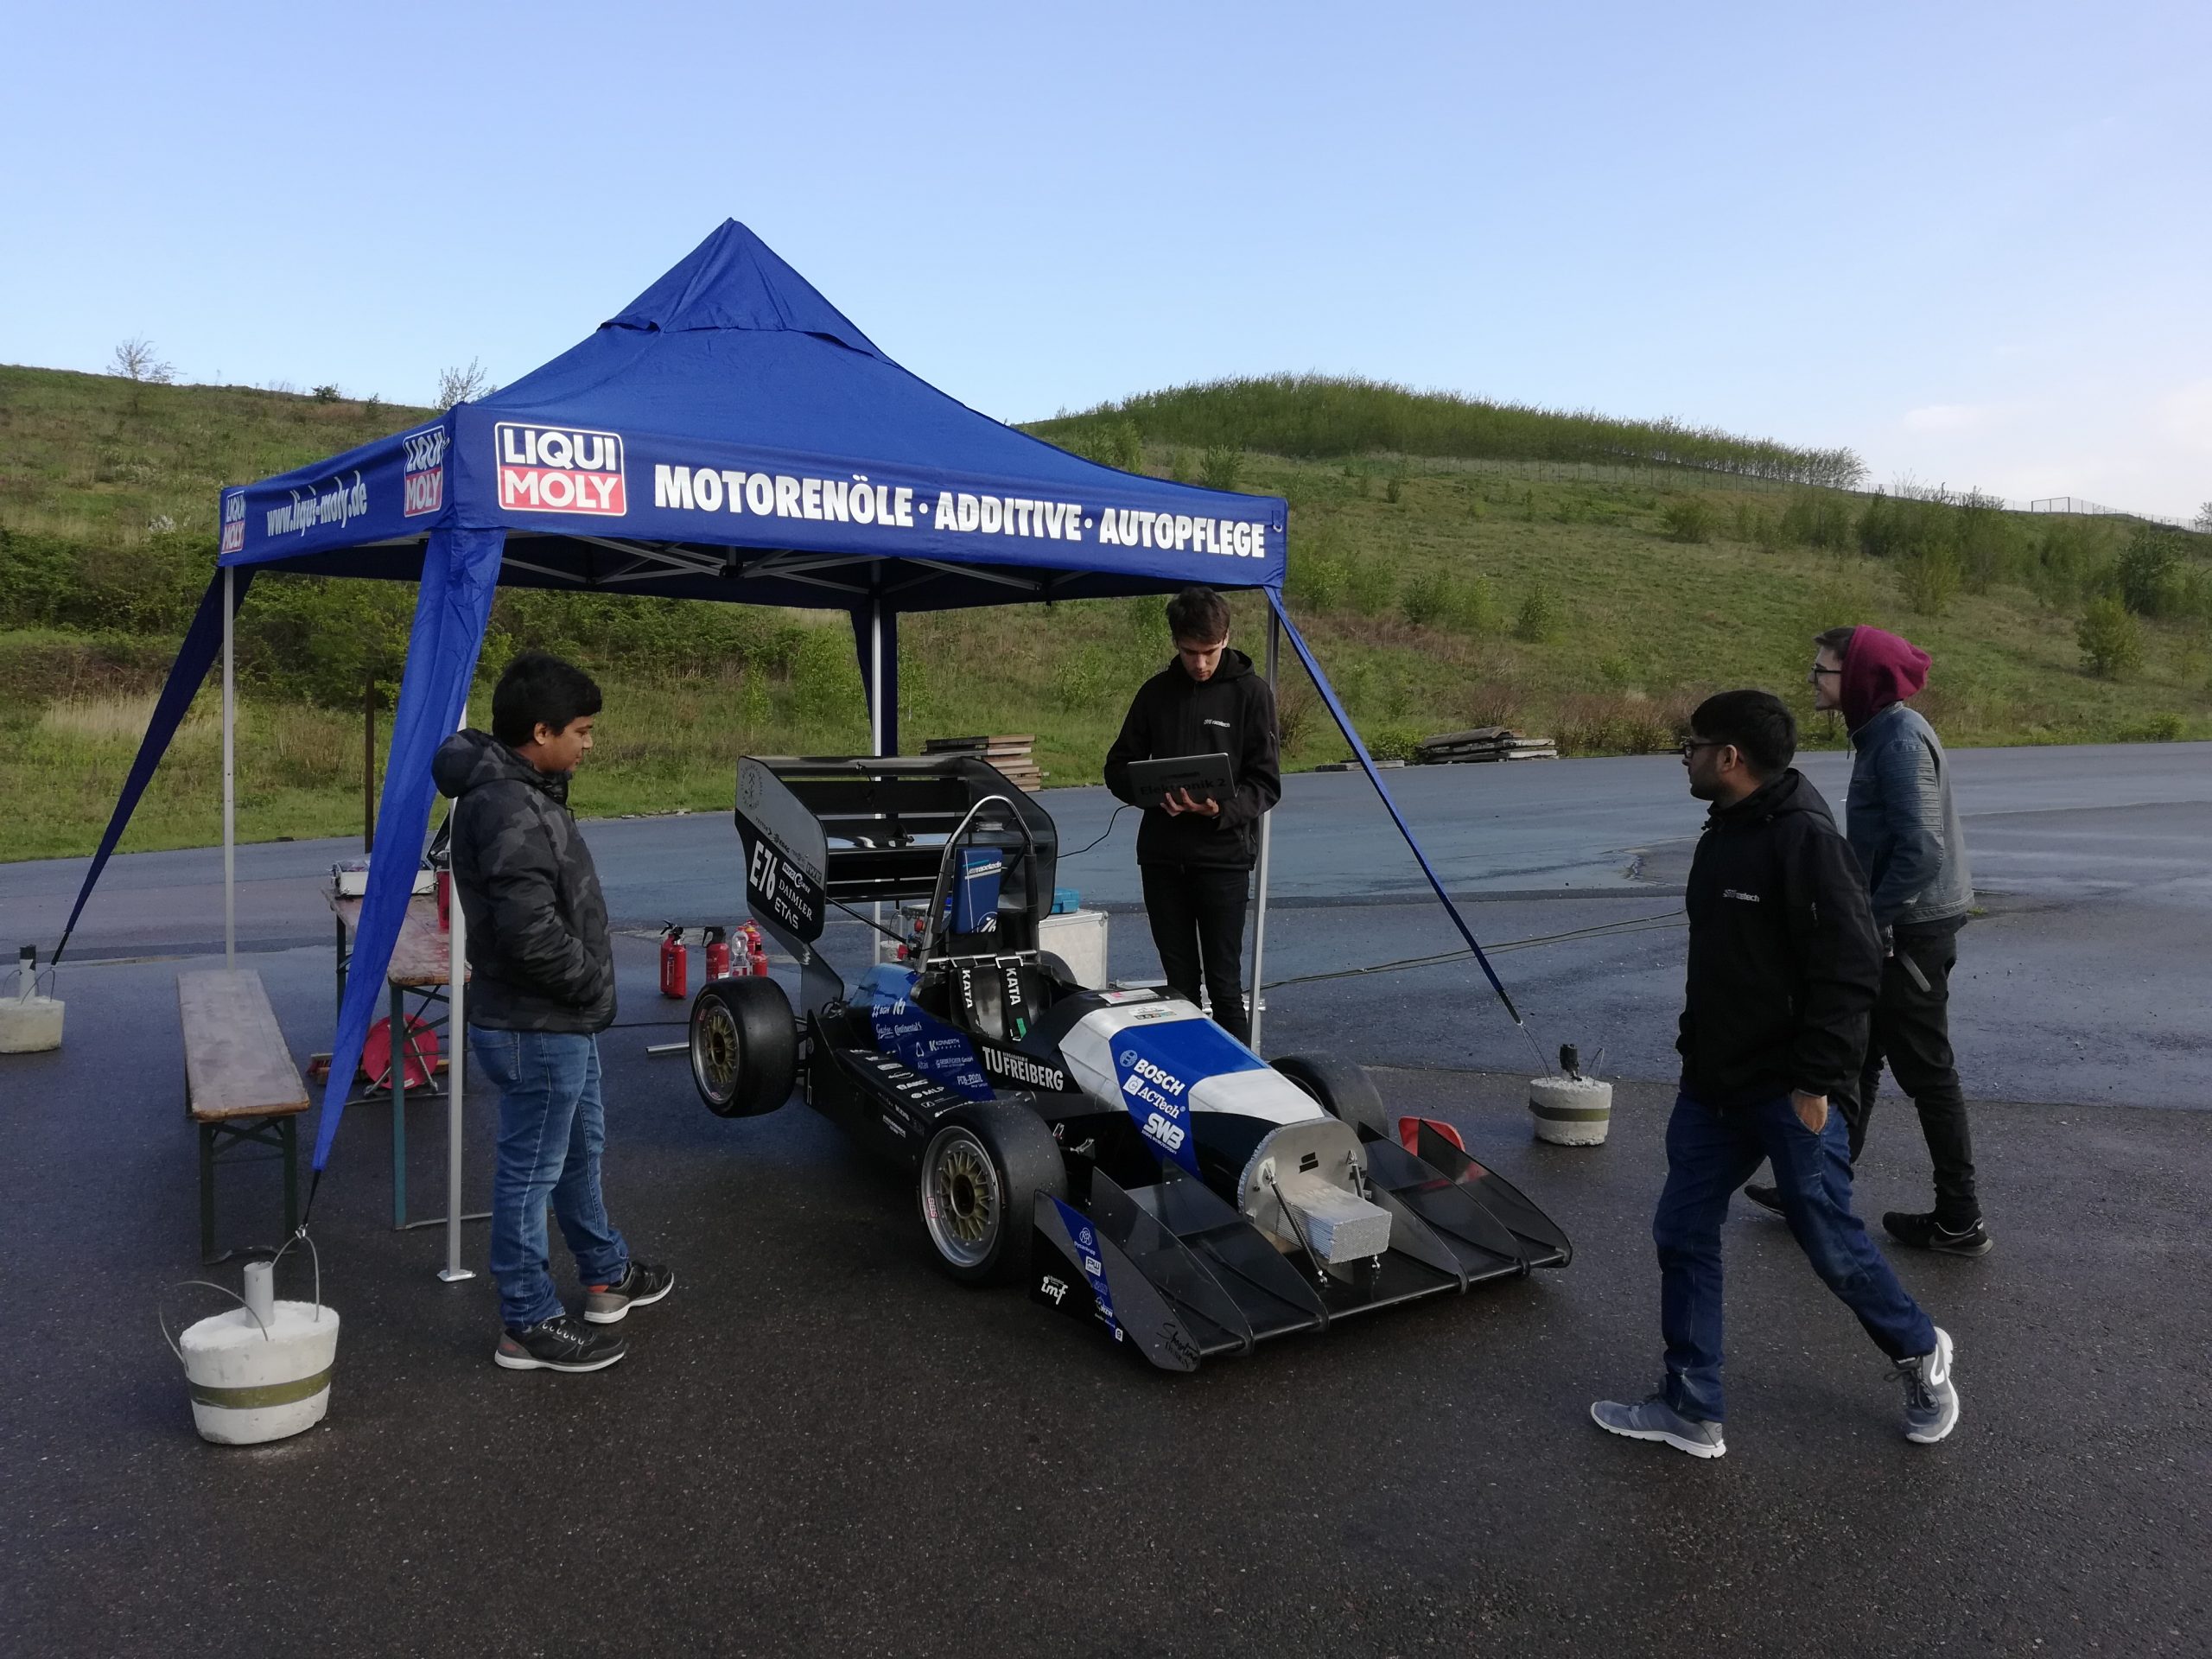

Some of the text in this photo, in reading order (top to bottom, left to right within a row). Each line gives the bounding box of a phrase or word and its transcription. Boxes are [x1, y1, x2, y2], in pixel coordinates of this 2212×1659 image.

[405, 432, 442, 473] LIQUI
[504, 429, 617, 472] LIQUI
[267, 470, 367, 537] www.liqui-moly.de
[405, 471, 442, 512] MOLY
[505, 472, 620, 510] MOLY
[655, 465, 1266, 558] MOTORENÖLE ADDITIVE AUTOPFLEGE
[221, 523, 245, 551] MOLY
[1217, 779, 1226, 787] 2
[749, 840, 778, 900] E76
[774, 897, 799, 931] ETAS
[779, 878, 813, 922] DAIMLER
[962, 969, 973, 1009] KATA
[1006, 967, 1021, 1006] KATA
[982, 1046, 1003, 1074] TU
[1003, 1056, 1065, 1092] FREIBERG
[1134, 1058, 1185, 1096] BOSCH
[1137, 1086, 1180, 1120] ACTech
